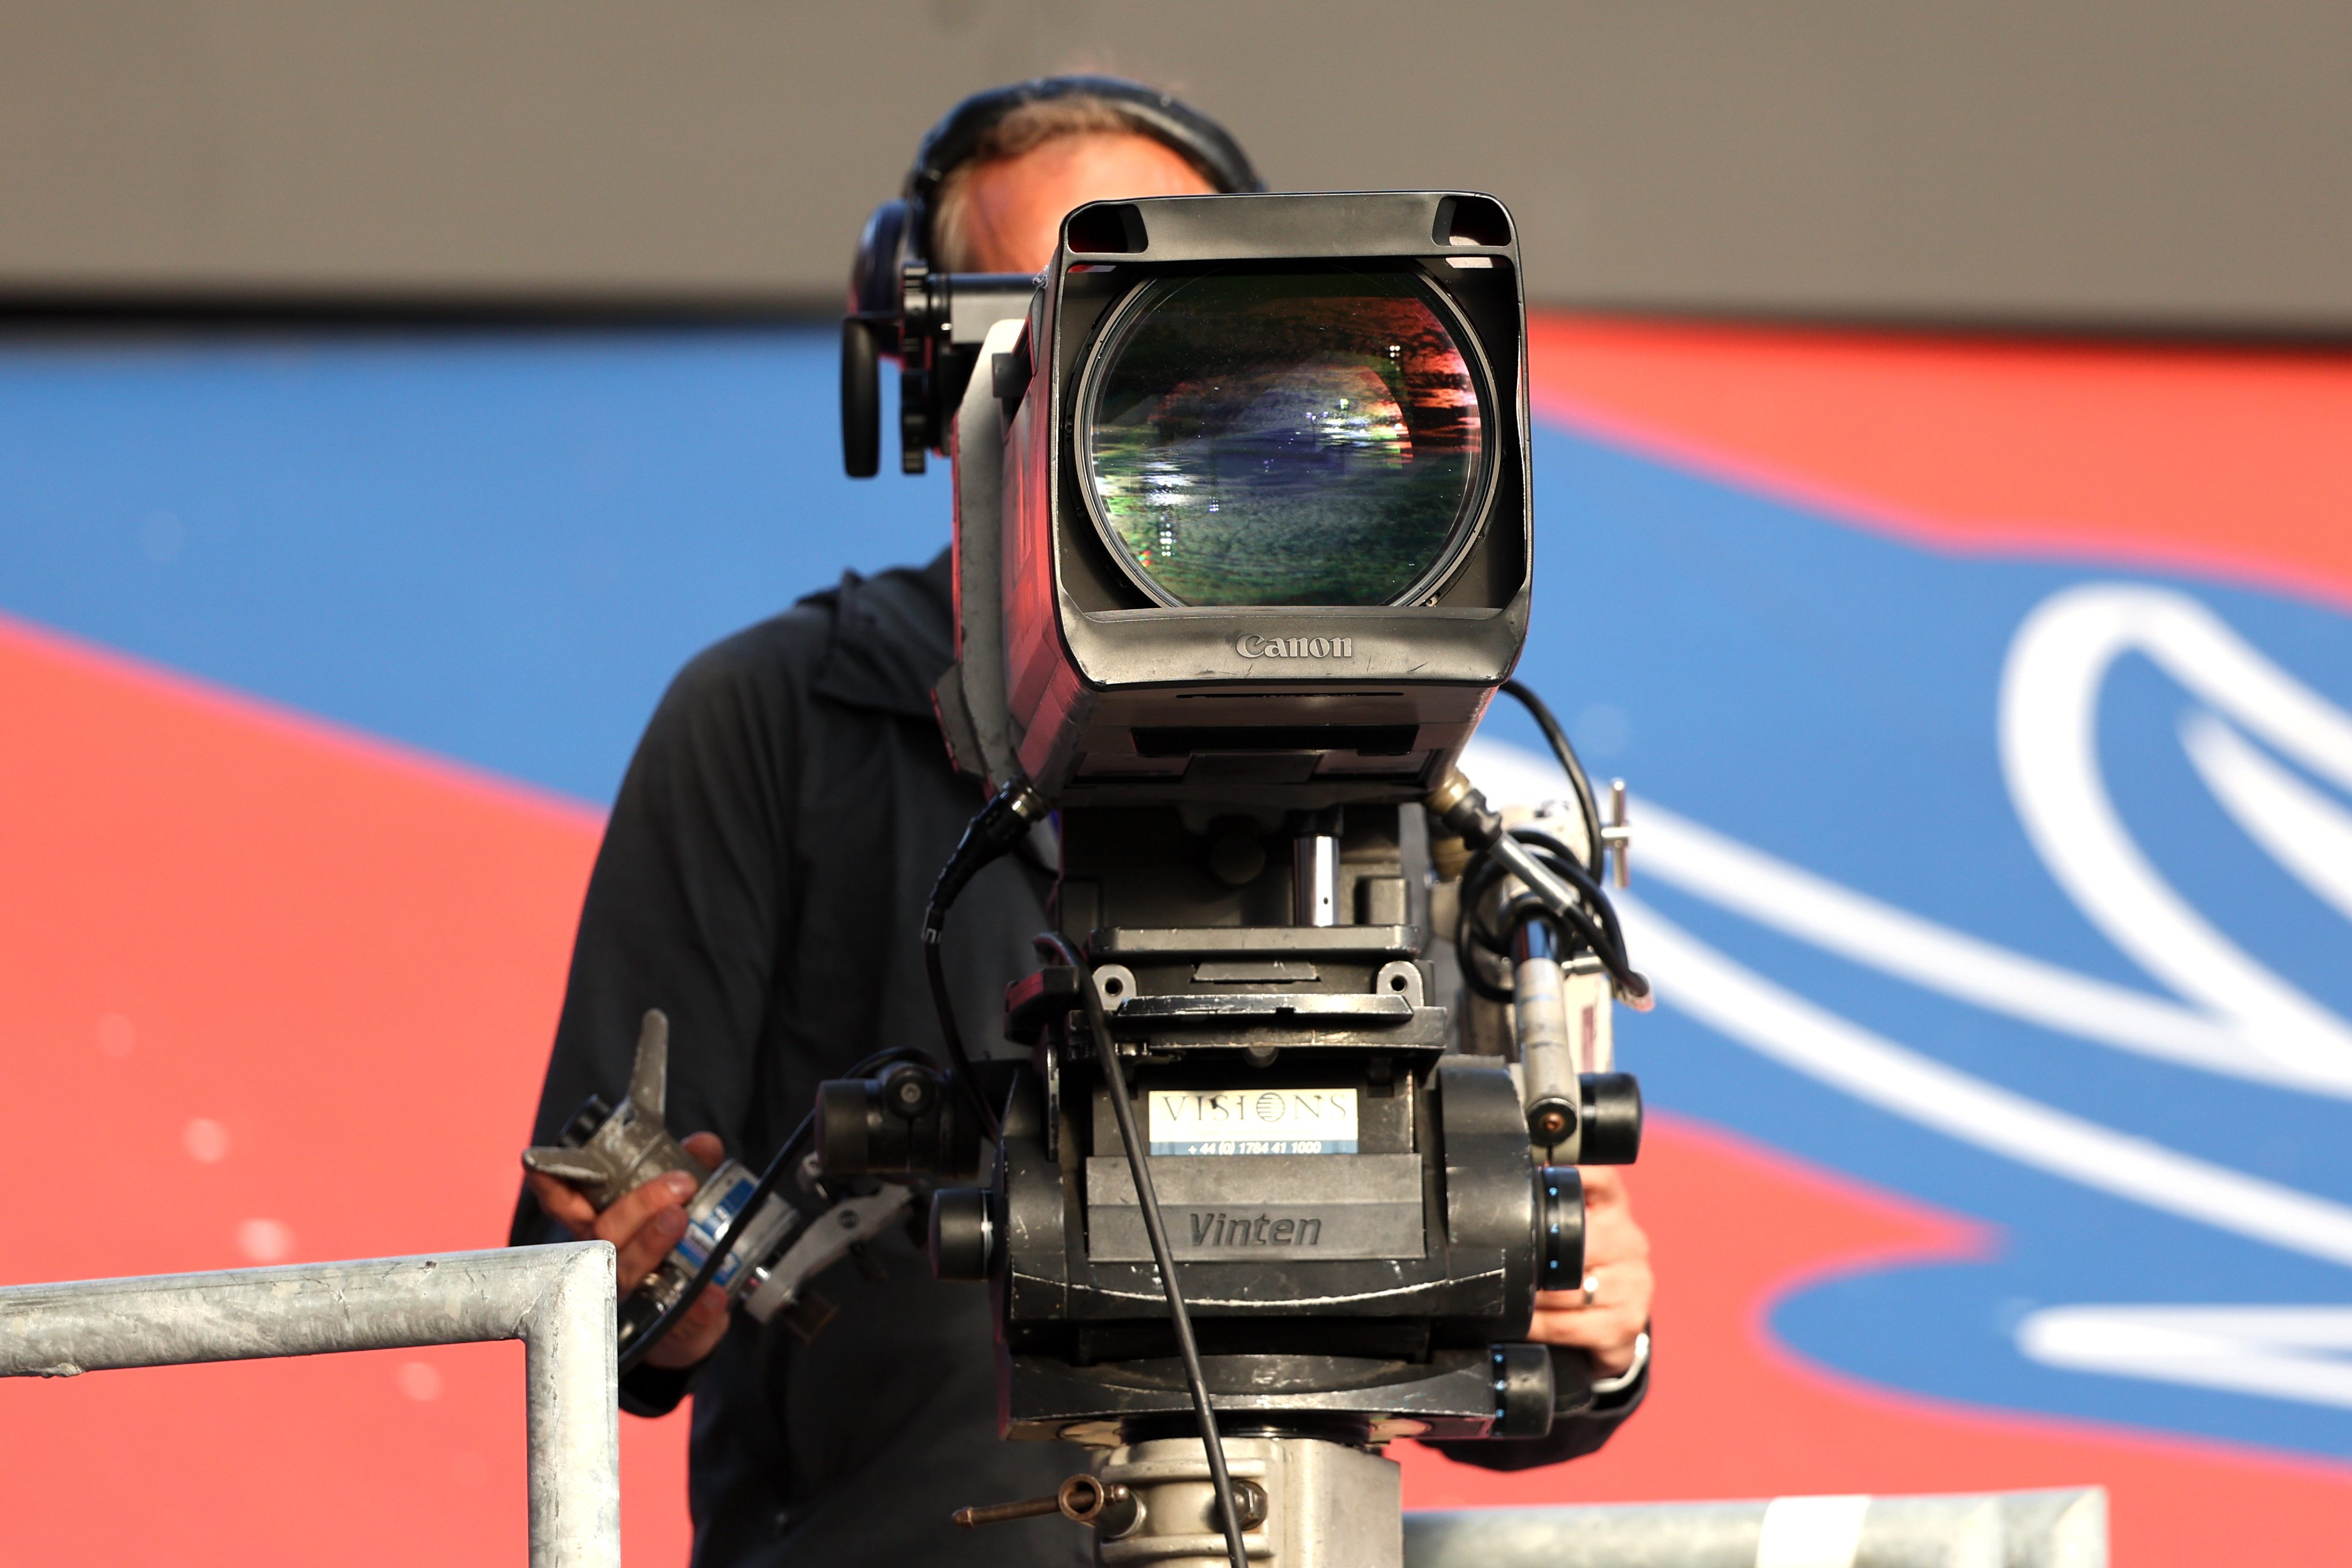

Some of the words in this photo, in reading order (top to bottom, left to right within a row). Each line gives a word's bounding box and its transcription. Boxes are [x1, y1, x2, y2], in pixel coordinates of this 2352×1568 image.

[1236, 633, 1352, 658] Canon
[1162, 1092, 1346, 1122] VISIONS
[1200, 1142, 1217, 1155] 44
[1219, 1141, 1236, 1155] (0)
[1239, 1141, 1268, 1155] 1784
[1271, 1141, 1286, 1154] 41
[1292, 1141, 1322, 1154] 1000
[1189, 1213, 1322, 1246] Vinten
